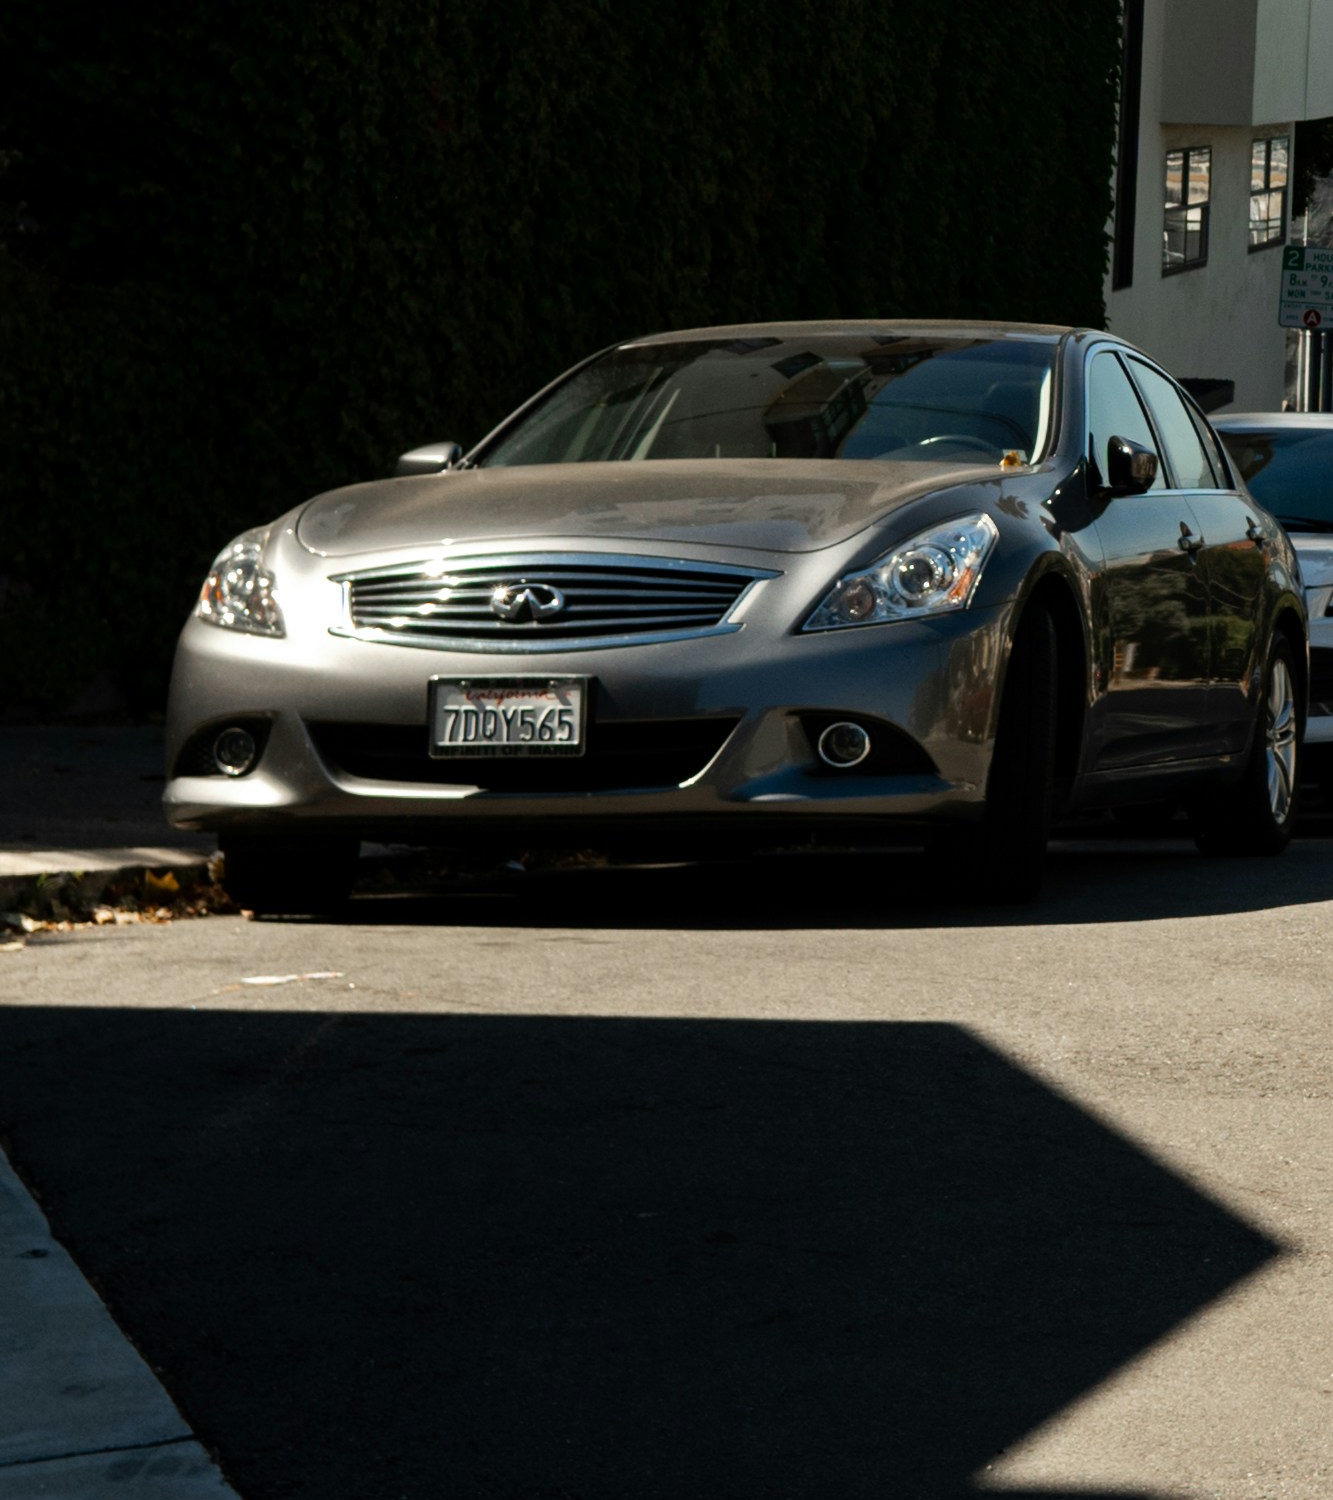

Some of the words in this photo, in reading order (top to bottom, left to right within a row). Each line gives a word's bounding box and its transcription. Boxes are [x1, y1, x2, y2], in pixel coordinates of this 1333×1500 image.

[1287, 249, 1300, 267] 2
[1287, 288, 1306, 298] MON
[1306, 311, 1318, 324] A
[443, 705, 574, 743] 7DQY565
